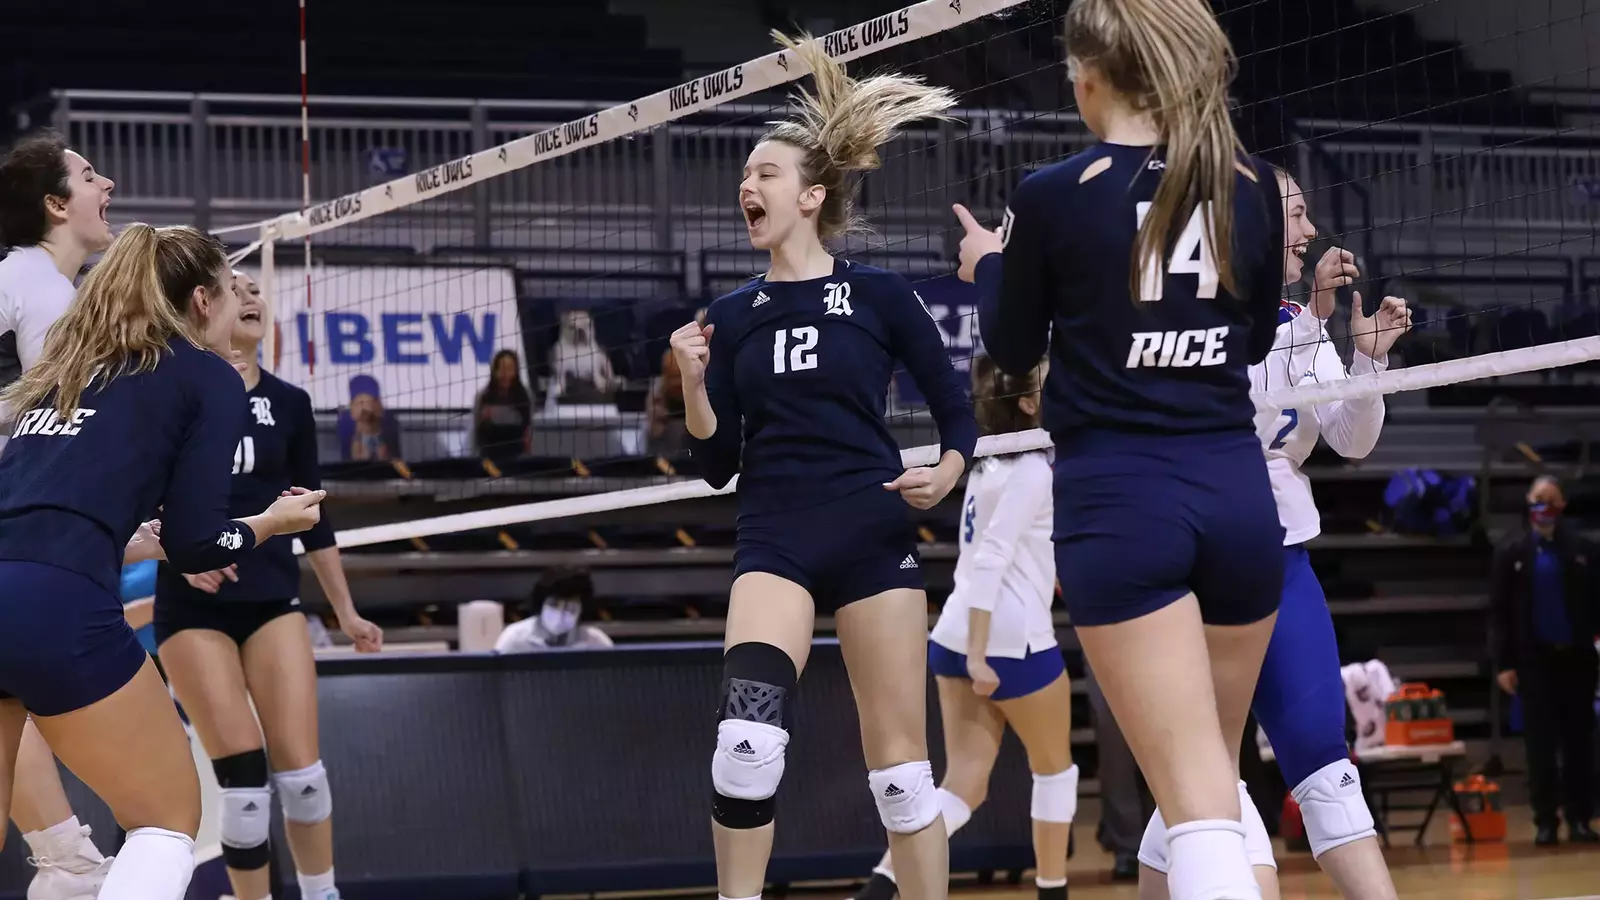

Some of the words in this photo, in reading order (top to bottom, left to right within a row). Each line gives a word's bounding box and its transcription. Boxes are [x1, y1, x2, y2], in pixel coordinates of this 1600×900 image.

[824, 26, 859, 58] RICE
[861, 8, 910, 47] OWLS
[669, 79, 699, 112] RICE
[702, 65, 744, 101] OWLS
[534, 127, 562, 156] RICE
[563, 113, 599, 146] OWLS
[415, 168, 440, 194] RICE
[442, 155, 473, 185] OWLS
[309, 202, 334, 227] RICE
[296, 311, 497, 365] IBEW
[773, 325, 819, 374] 12
[1126, 325, 1229, 369] RICE
[11, 407, 97, 440] RICE
[733, 747, 756, 755] adidas
[884, 789, 905, 797] adidas
